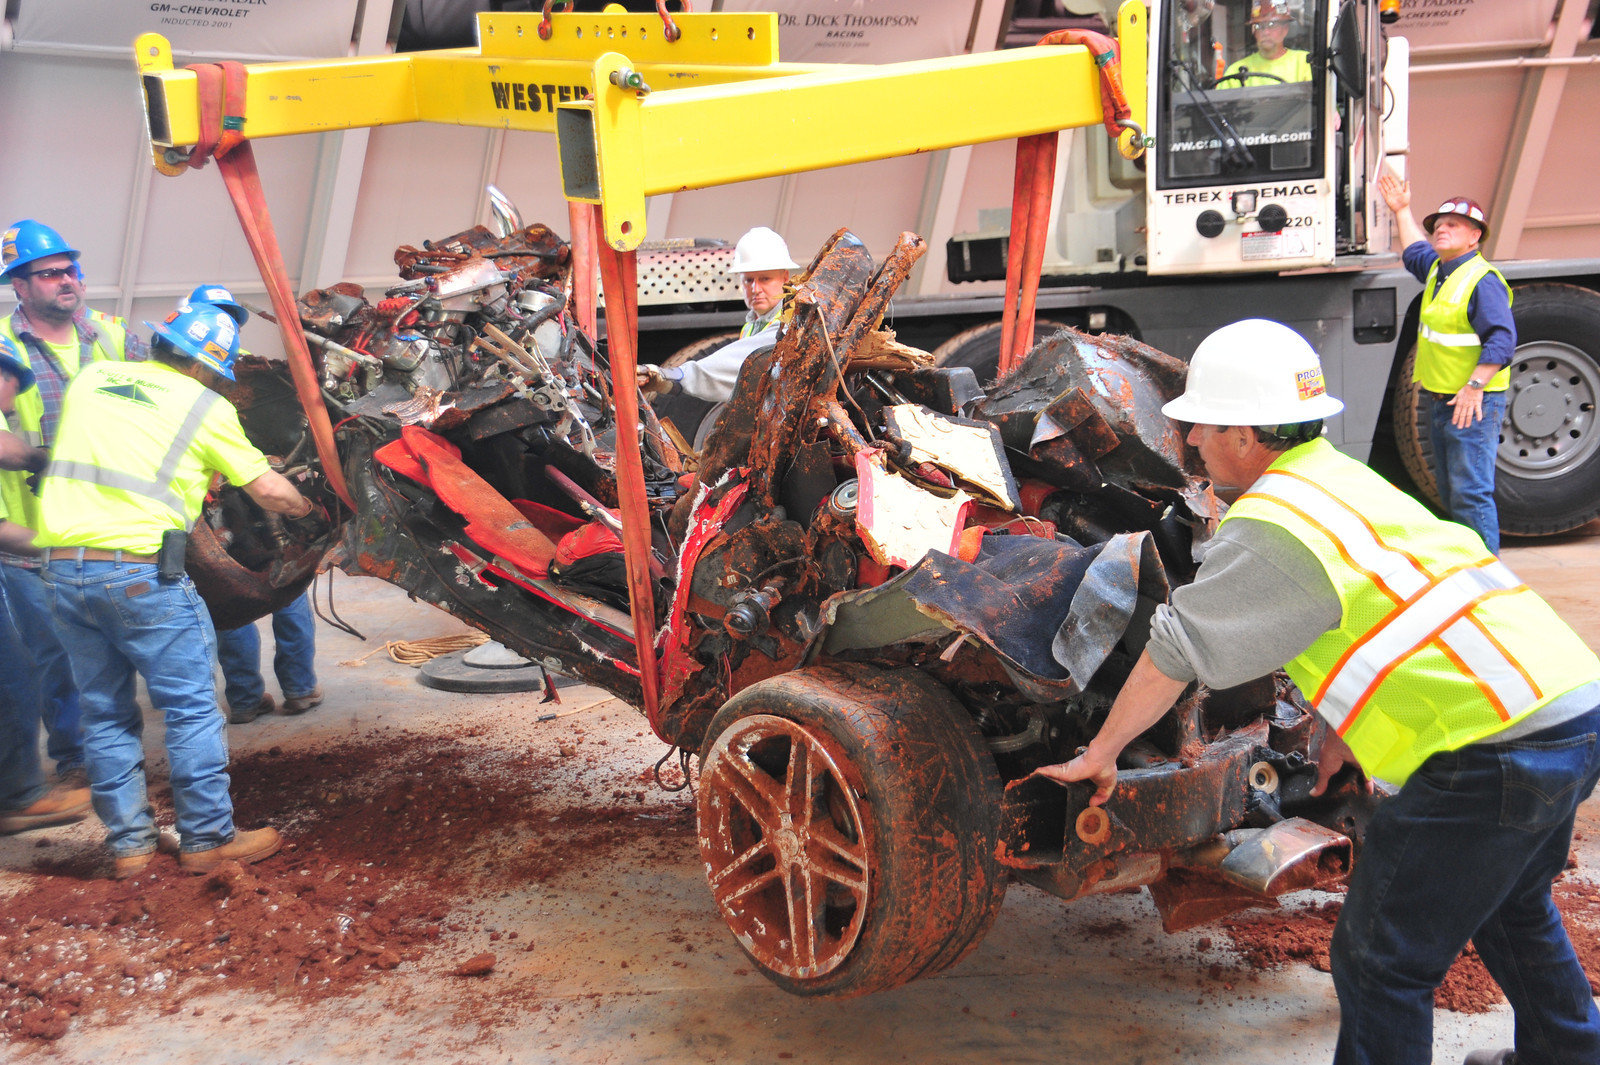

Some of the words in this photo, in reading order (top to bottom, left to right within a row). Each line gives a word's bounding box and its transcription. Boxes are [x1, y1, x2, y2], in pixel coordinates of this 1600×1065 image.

[160, 17, 210, 27] INDUCTED
[211, 20, 233, 28] 2001
[805, 13, 840, 27] DICK
[842, 13, 919, 27] THOMPSON
[826, 30, 865, 38] RACING
[491, 81, 593, 113] WESTER
[1163, 191, 1222, 205] TEREX
